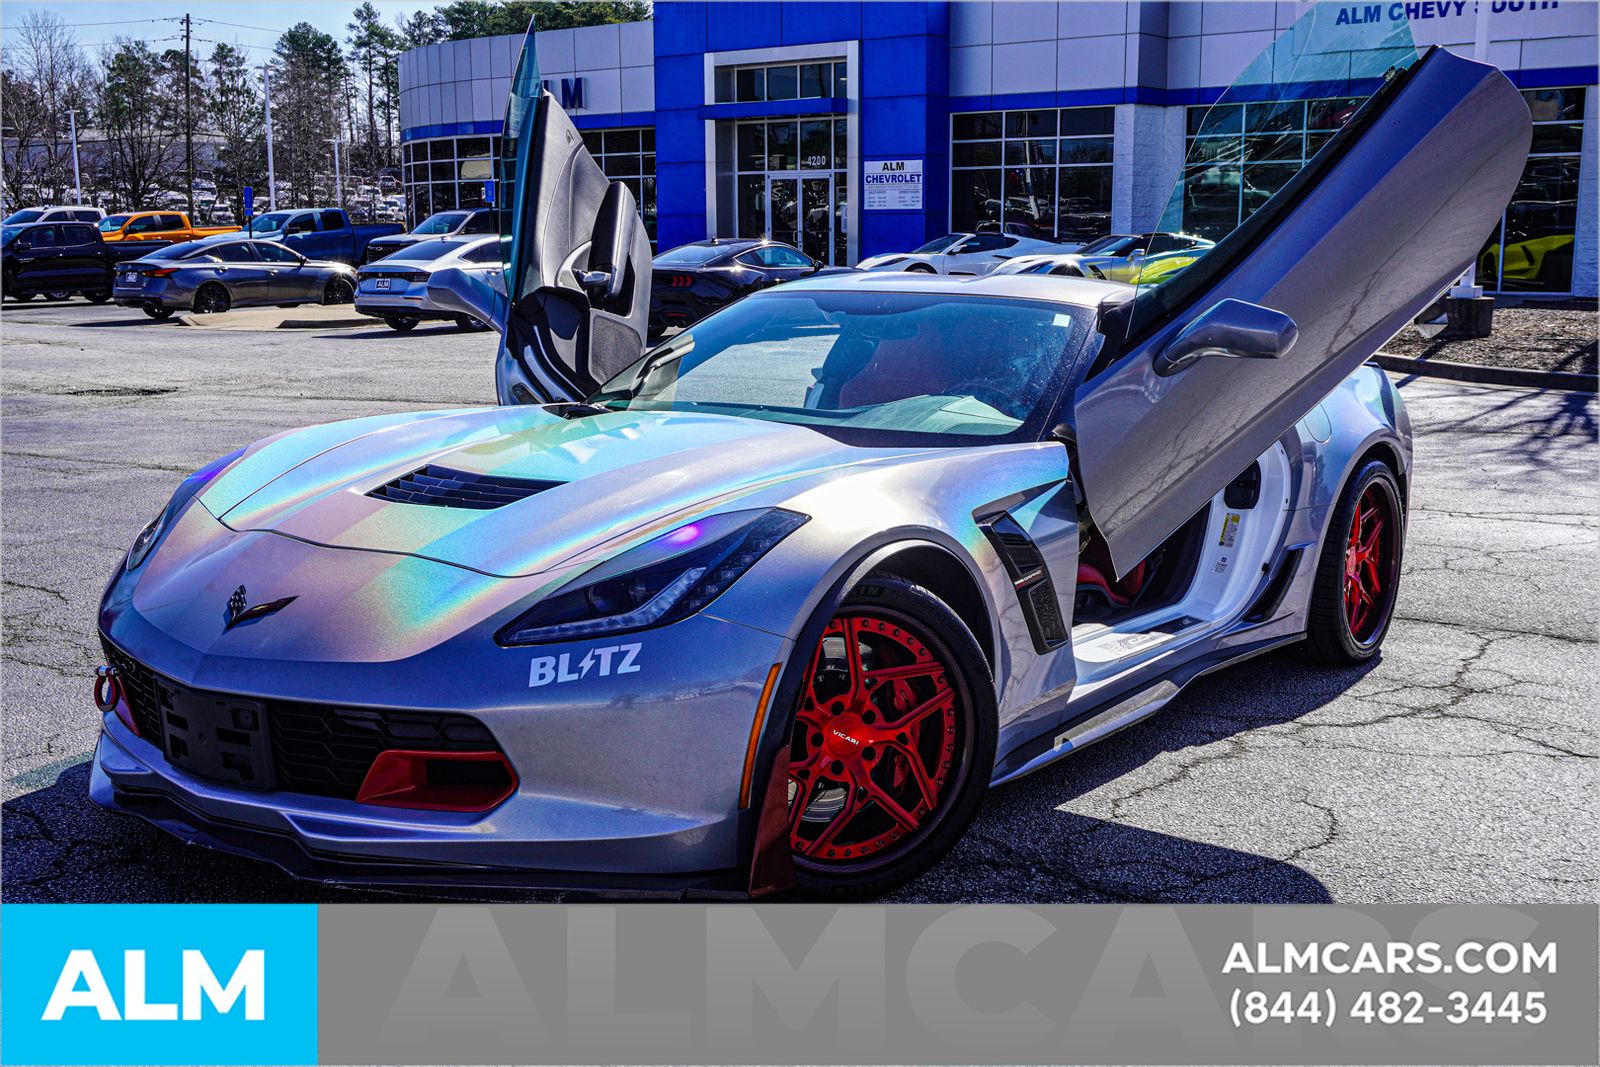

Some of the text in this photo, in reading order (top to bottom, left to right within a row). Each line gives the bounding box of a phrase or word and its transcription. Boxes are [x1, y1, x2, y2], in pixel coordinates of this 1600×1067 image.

[1335, 6, 1382, 26] ALM
[1388, 1, 1465, 20] CHEVY
[807, 155, 826, 166] 4200
[881, 161, 905, 172] ALM
[865, 173, 922, 184] CHEVROLET
[528, 642, 643, 688] BLITZ
[832, 729, 859, 746] VICARI
